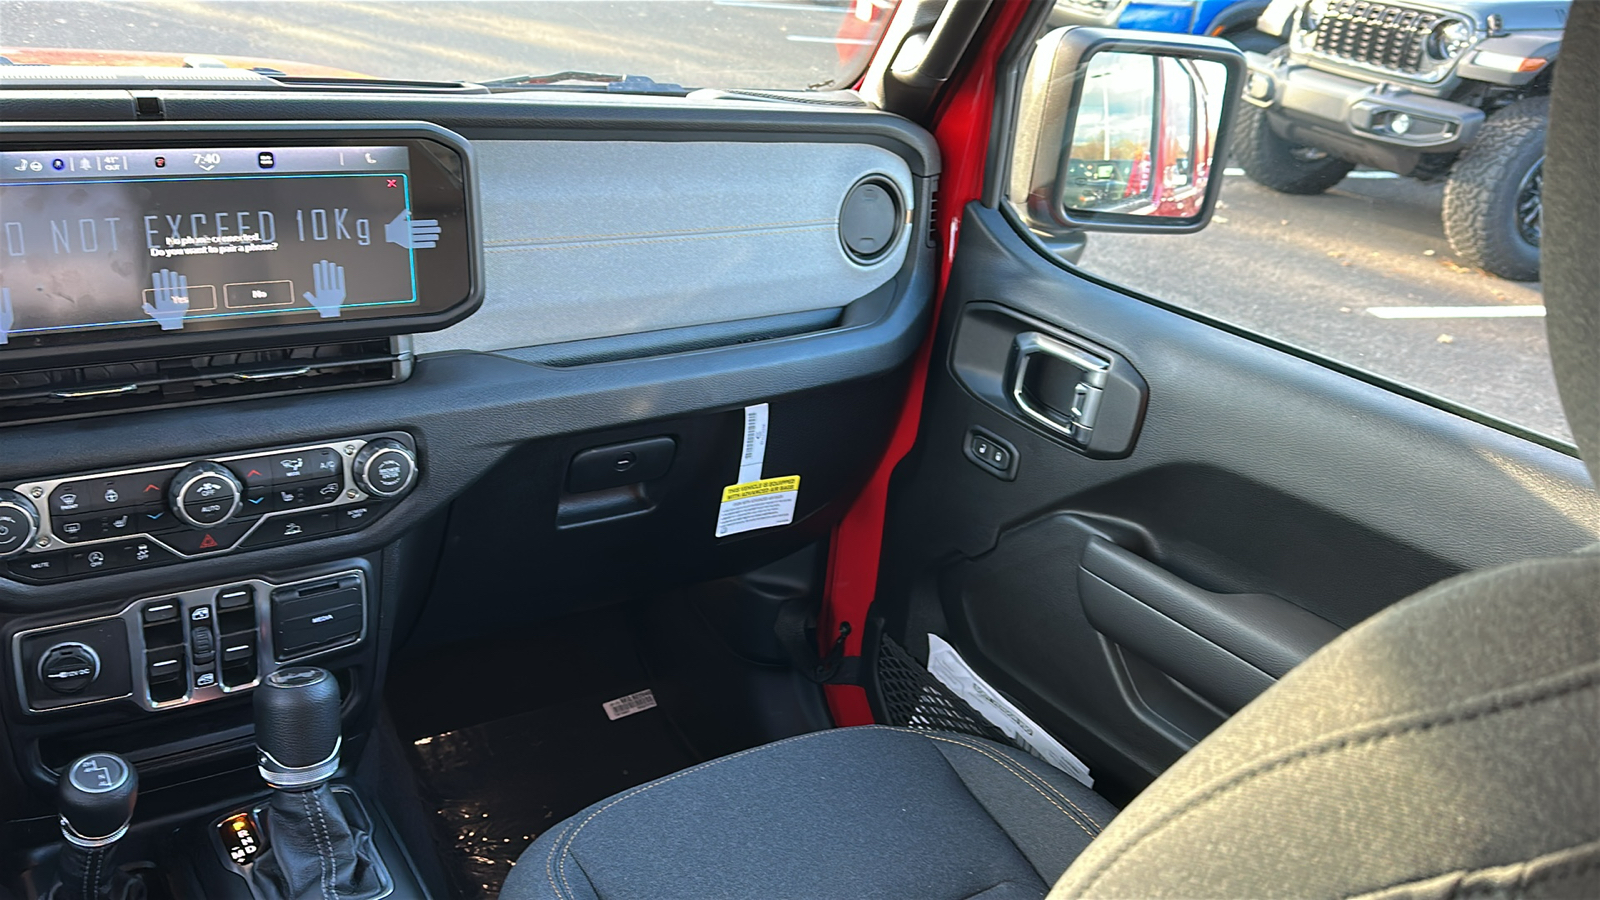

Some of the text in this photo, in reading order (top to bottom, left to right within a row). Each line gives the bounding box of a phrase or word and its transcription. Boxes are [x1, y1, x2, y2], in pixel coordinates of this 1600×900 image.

[193, 153, 220, 164] 7:40
[50, 217, 120, 254] NOT
[143, 211, 276, 249] EXCEED
[296, 208, 371, 246] 10Kg
[150, 247, 165, 257] Do
[165, 248, 184, 257] you
[184, 246, 208, 254] want
[208, 245, 218, 254] to
[219, 244, 237, 254] pair
[245, 242, 278, 253] phone?
[252, 290, 267, 298] No
[171, 295, 189, 304] Yes
[201, 488, 215, 497] OFF
[201, 504, 220, 513] AUTO
[30, 561, 49, 569] MUTE
[240, 836, 254, 846] N
[244, 845, 257, 854] D
